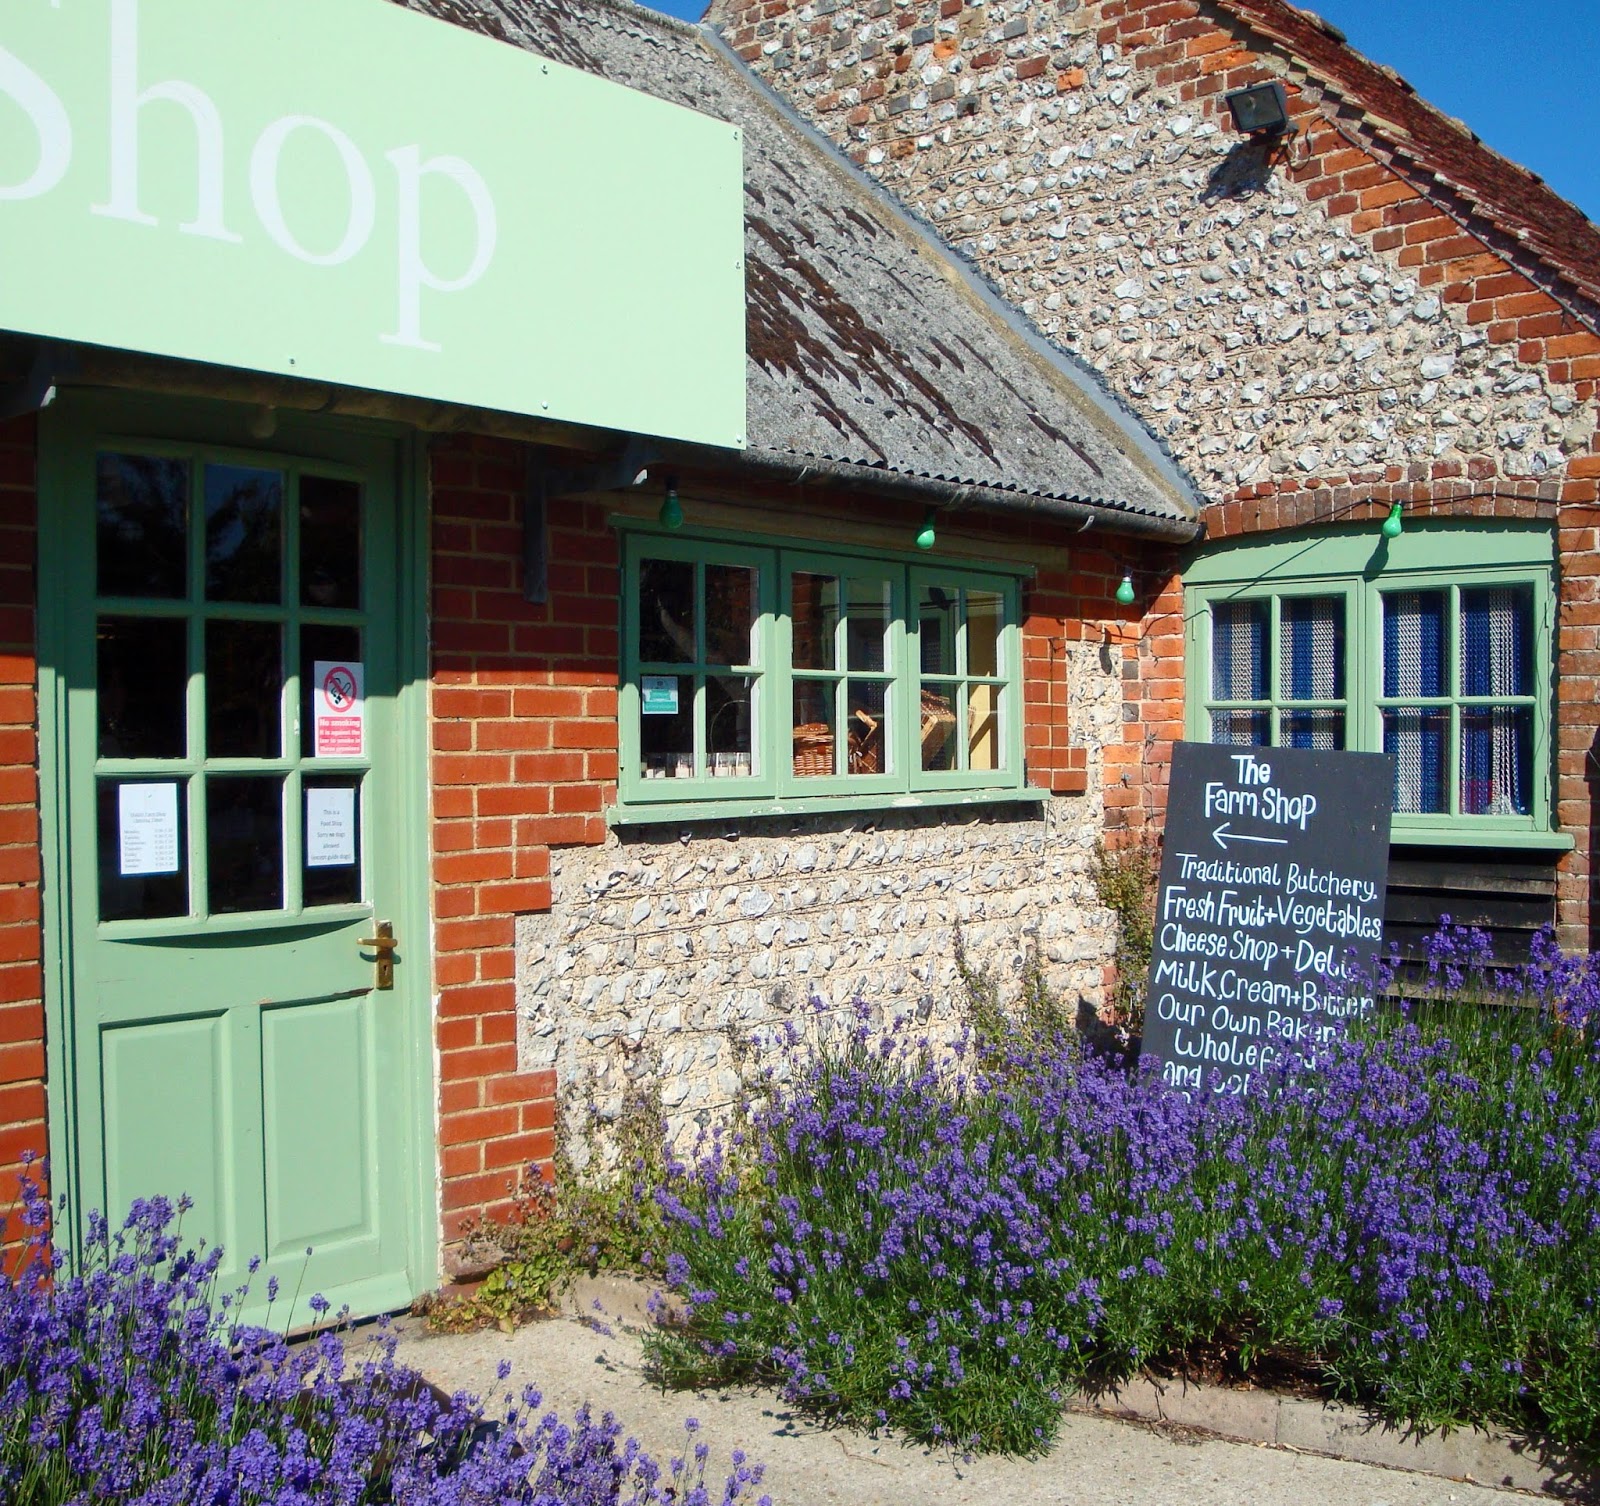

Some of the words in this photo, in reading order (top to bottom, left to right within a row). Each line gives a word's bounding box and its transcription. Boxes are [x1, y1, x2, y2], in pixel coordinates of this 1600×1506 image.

[1231, 755, 1271, 785] The
[1204, 782, 1258, 818] Farm
[1261, 787, 1317, 831] Shop
[1175, 853, 1281, 886] Traditional
[1286, 862, 1378, 903] Butchery,
[1163, 886, 1215, 923] Fresh
[1160, 922, 1227, 957] Cheese
[1229, 930, 1279, 972] Shop
[1158, 993, 1205, 1026] Our
[1211, 1005, 1261, 1036] Own
[1267, 1010, 1349, 1044] Baker
[1163, 1060, 1202, 1089] and
